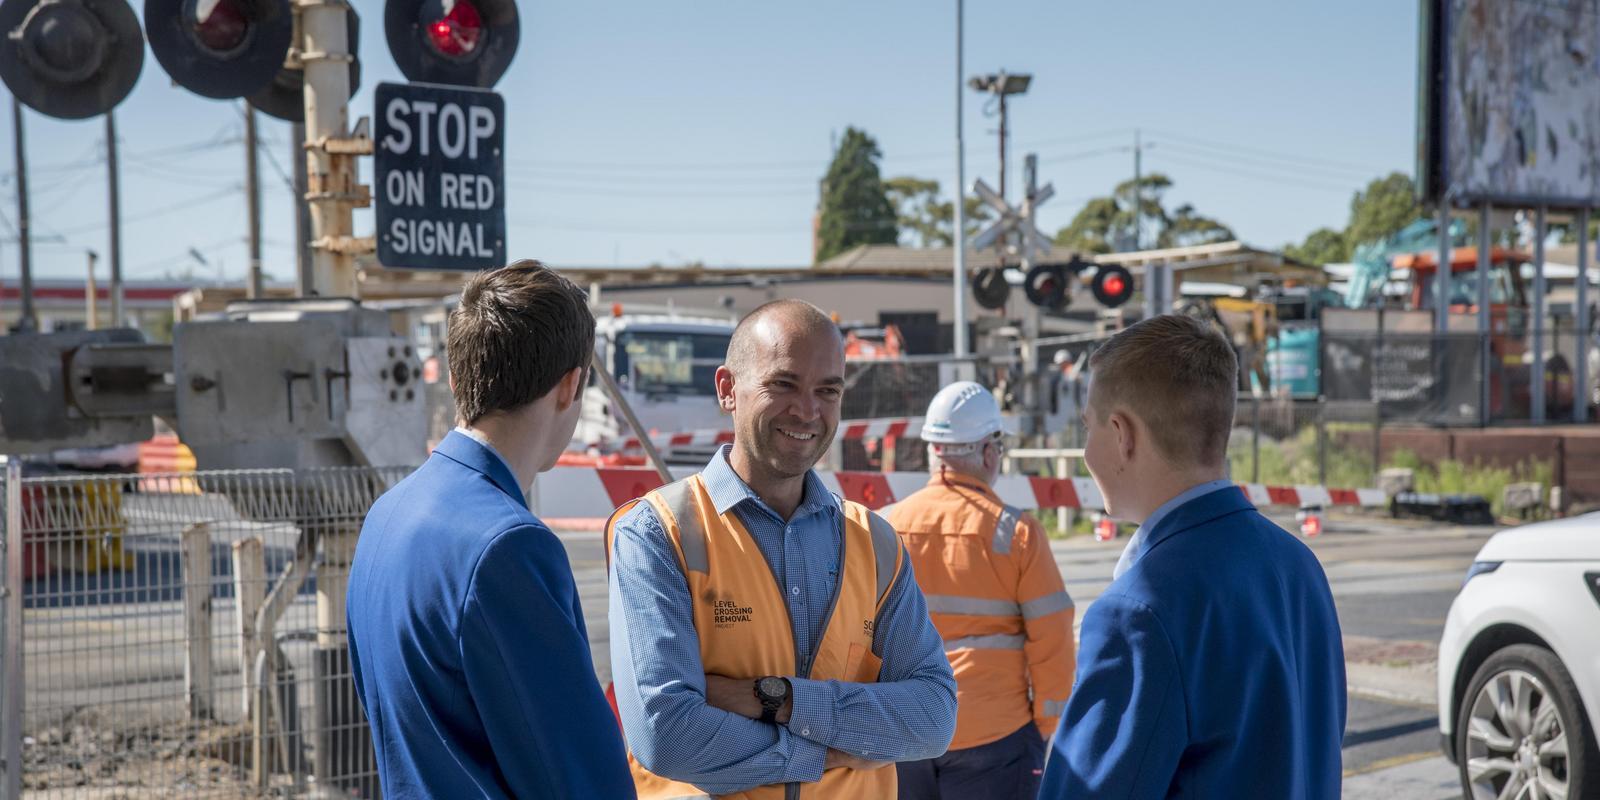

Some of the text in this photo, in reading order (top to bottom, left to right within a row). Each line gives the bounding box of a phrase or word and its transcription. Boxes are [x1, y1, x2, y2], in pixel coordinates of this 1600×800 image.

[386, 98, 496, 159] STOP
[386, 169, 494, 210] ON RED
[391, 218, 494, 258] SIGNAL
[714, 600, 737, 608] LEVEL
[714, 607, 752, 616] CROSSING
[714, 615, 752, 623] REMOVAL
